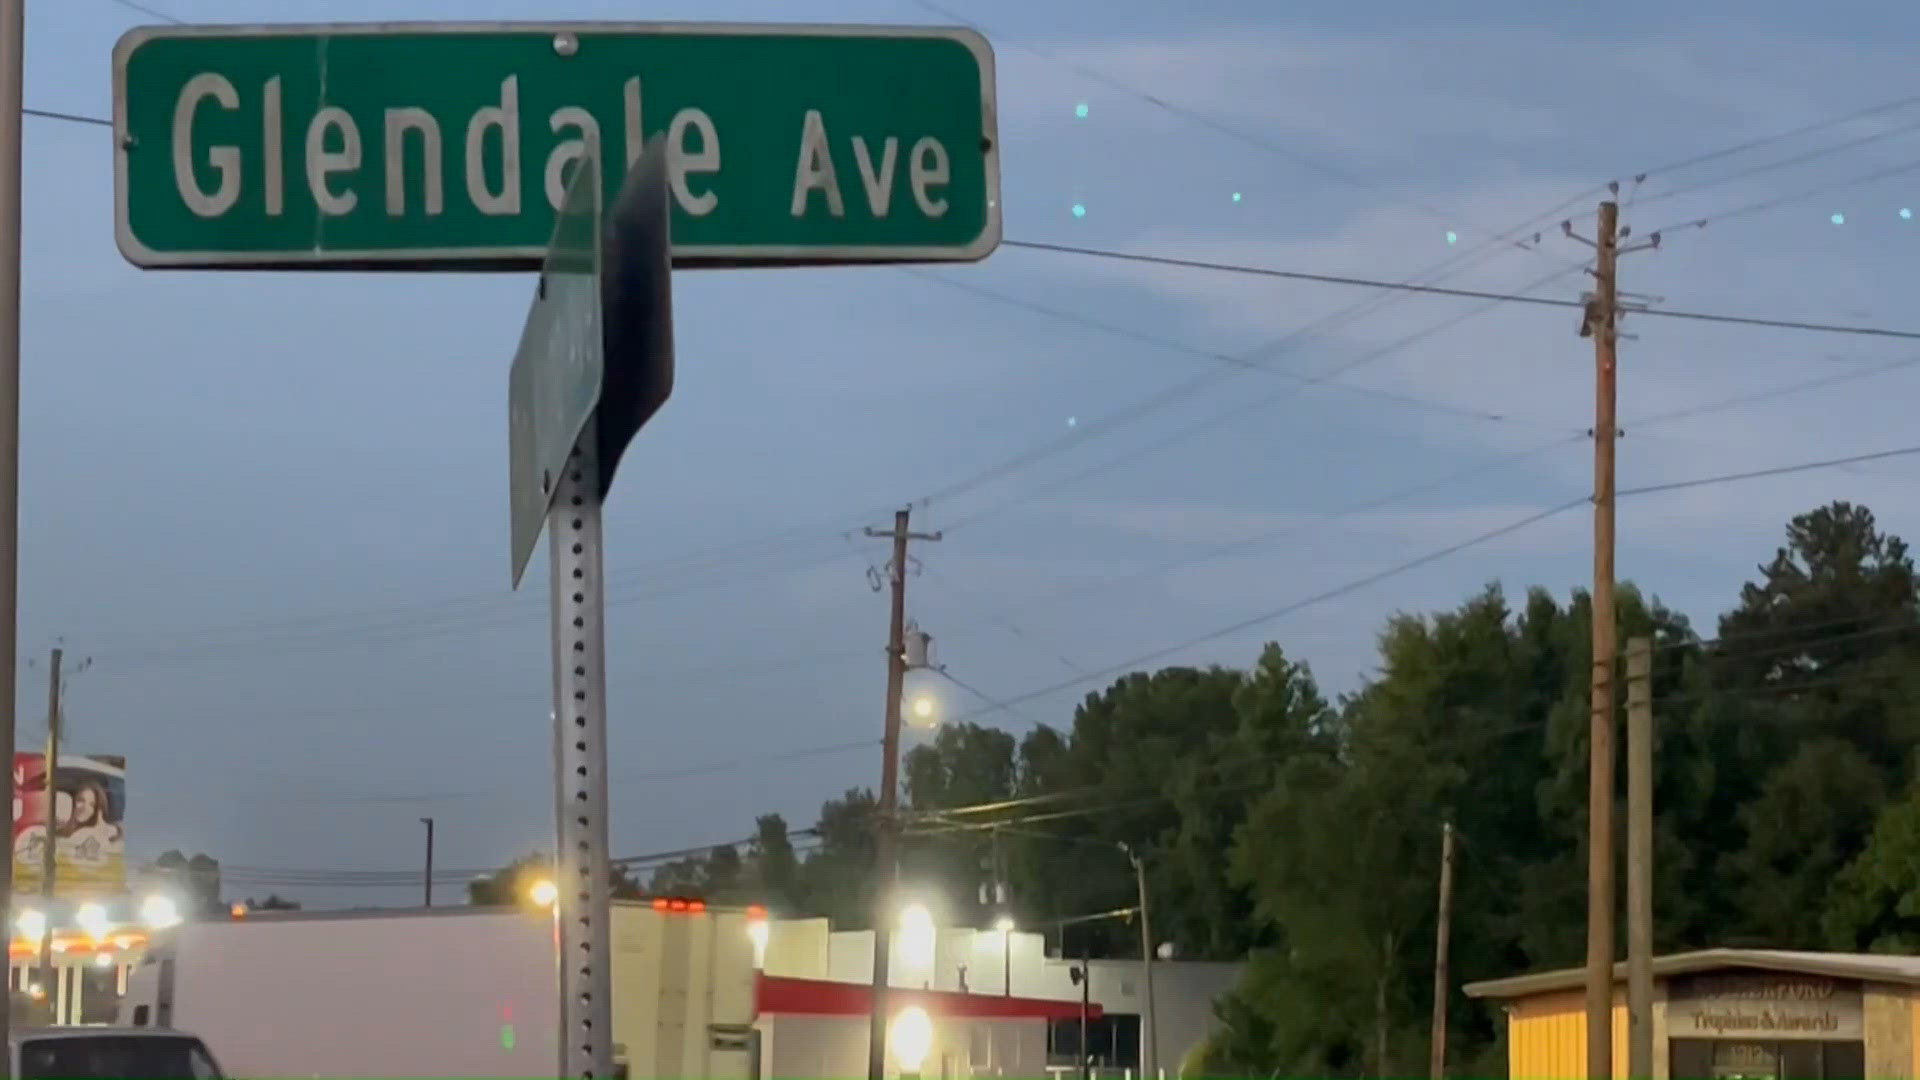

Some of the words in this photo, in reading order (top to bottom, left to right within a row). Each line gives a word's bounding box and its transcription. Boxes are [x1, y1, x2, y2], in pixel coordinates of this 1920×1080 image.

[172, 72, 721, 218] Glendale
[790, 109, 952, 219] Ave
[1776, 1010, 1839, 1032] Awards
